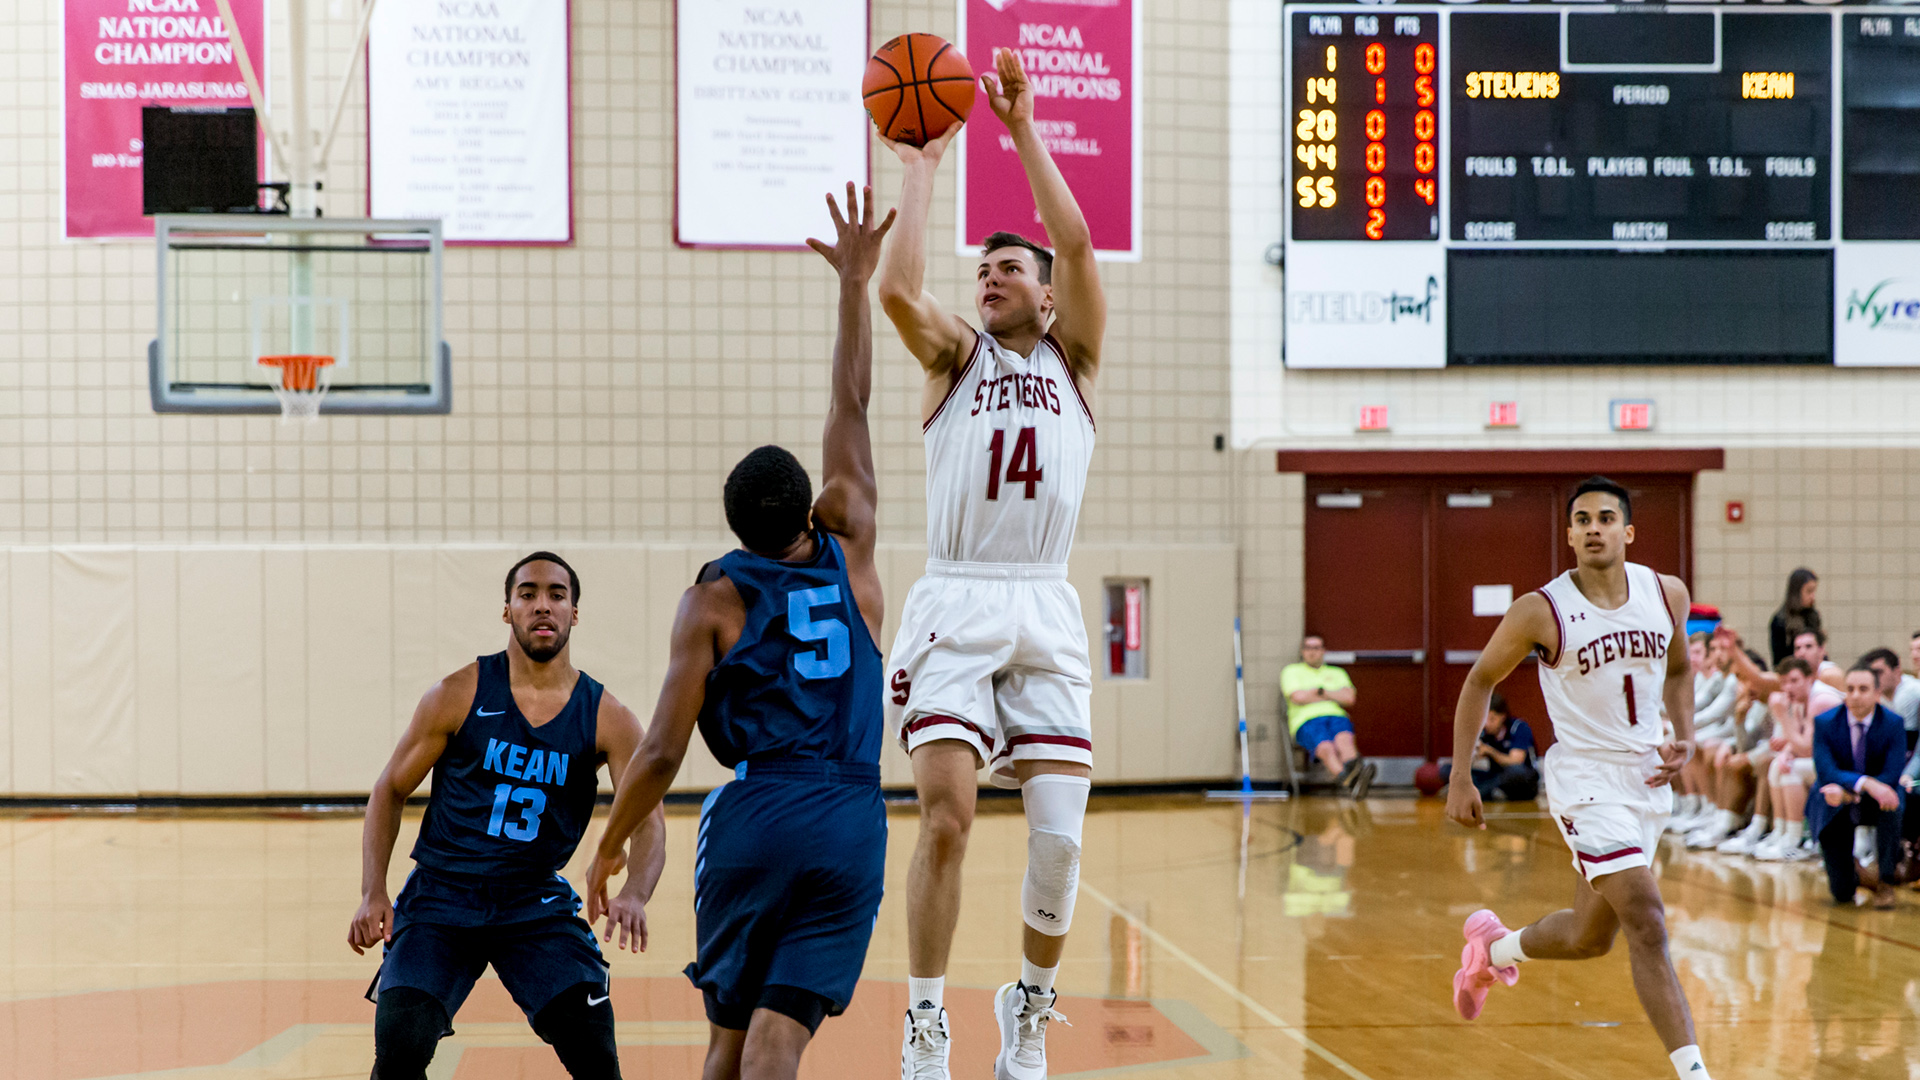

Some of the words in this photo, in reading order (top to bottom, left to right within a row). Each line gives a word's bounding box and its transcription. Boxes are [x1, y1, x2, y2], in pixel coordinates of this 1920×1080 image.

[438, 1, 500, 19] NCAA
[743, 8, 804, 27] NCAA
[98, 17, 230, 38] NATIONAL
[411, 25, 527, 44] NATIONAL
[1019, 23, 1084, 48] NCAA
[1309, 15, 1342, 36] PLYR
[1354, 15, 1379, 36] FLS
[1394, 15, 1420, 36] PTS
[95, 42, 232, 64] CHAMPION
[718, 31, 829, 52] NATIONAL
[406, 49, 530, 68] CHAMPION
[713, 55, 833, 76] CHAMPION
[1326, 45, 1337, 72] 1
[1365, 42, 1386, 75] 0
[1414, 42, 1435, 75] 0
[80, 82, 137, 99] SIMAS
[138, 82, 249, 99] JARASUNAS
[979, 71, 1121, 101] CMPIONS
[1307, 77, 1337, 104] 14
[1375, 77, 1386, 104] 1
[1414, 75, 1435, 107] 5
[1466, 72, 1560, 98] STEVENS
[1613, 85, 1670, 104] PERIOD
[1742, 72, 1795, 99] KEAN
[1296, 109, 1337, 141] 20
[1365, 109, 1386, 141] 0
[1414, 109, 1435, 142] 0
[92, 154, 143, 168] 100-Yar
[1296, 144, 1337, 170] 44
[1365, 141, 1386, 173] 0
[1414, 141, 1435, 174] 0
[1465, 156, 1517, 177] FOULS
[1531, 156, 1575, 177] T.O.L.
[1587, 156, 1647, 177] PLAYER
[1654, 156, 1694, 177] FOUL
[1707, 156, 1751, 177] T.O.L.
[1765, 156, 1816, 177] FOULS
[1296, 176, 1337, 208] 55
[1365, 176, 1386, 208] 0
[1414, 178, 1435, 206] 4
[1365, 208, 1386, 240] 2
[1464, 221, 1516, 241] SCORE
[1613, 221, 1668, 241] MATCH
[1765, 221, 1816, 241] SCORE
[971, 373, 1061, 417] STEVENS
[985, 426, 1044, 501] 14
[788, 584, 850, 679] 5
[1577, 630, 1666, 676] STEVENS
[891, 669, 911, 706] S
[1623, 674, 1638, 727] 1
[483, 738, 569, 786] KEAN
[487, 783, 547, 842] 13
